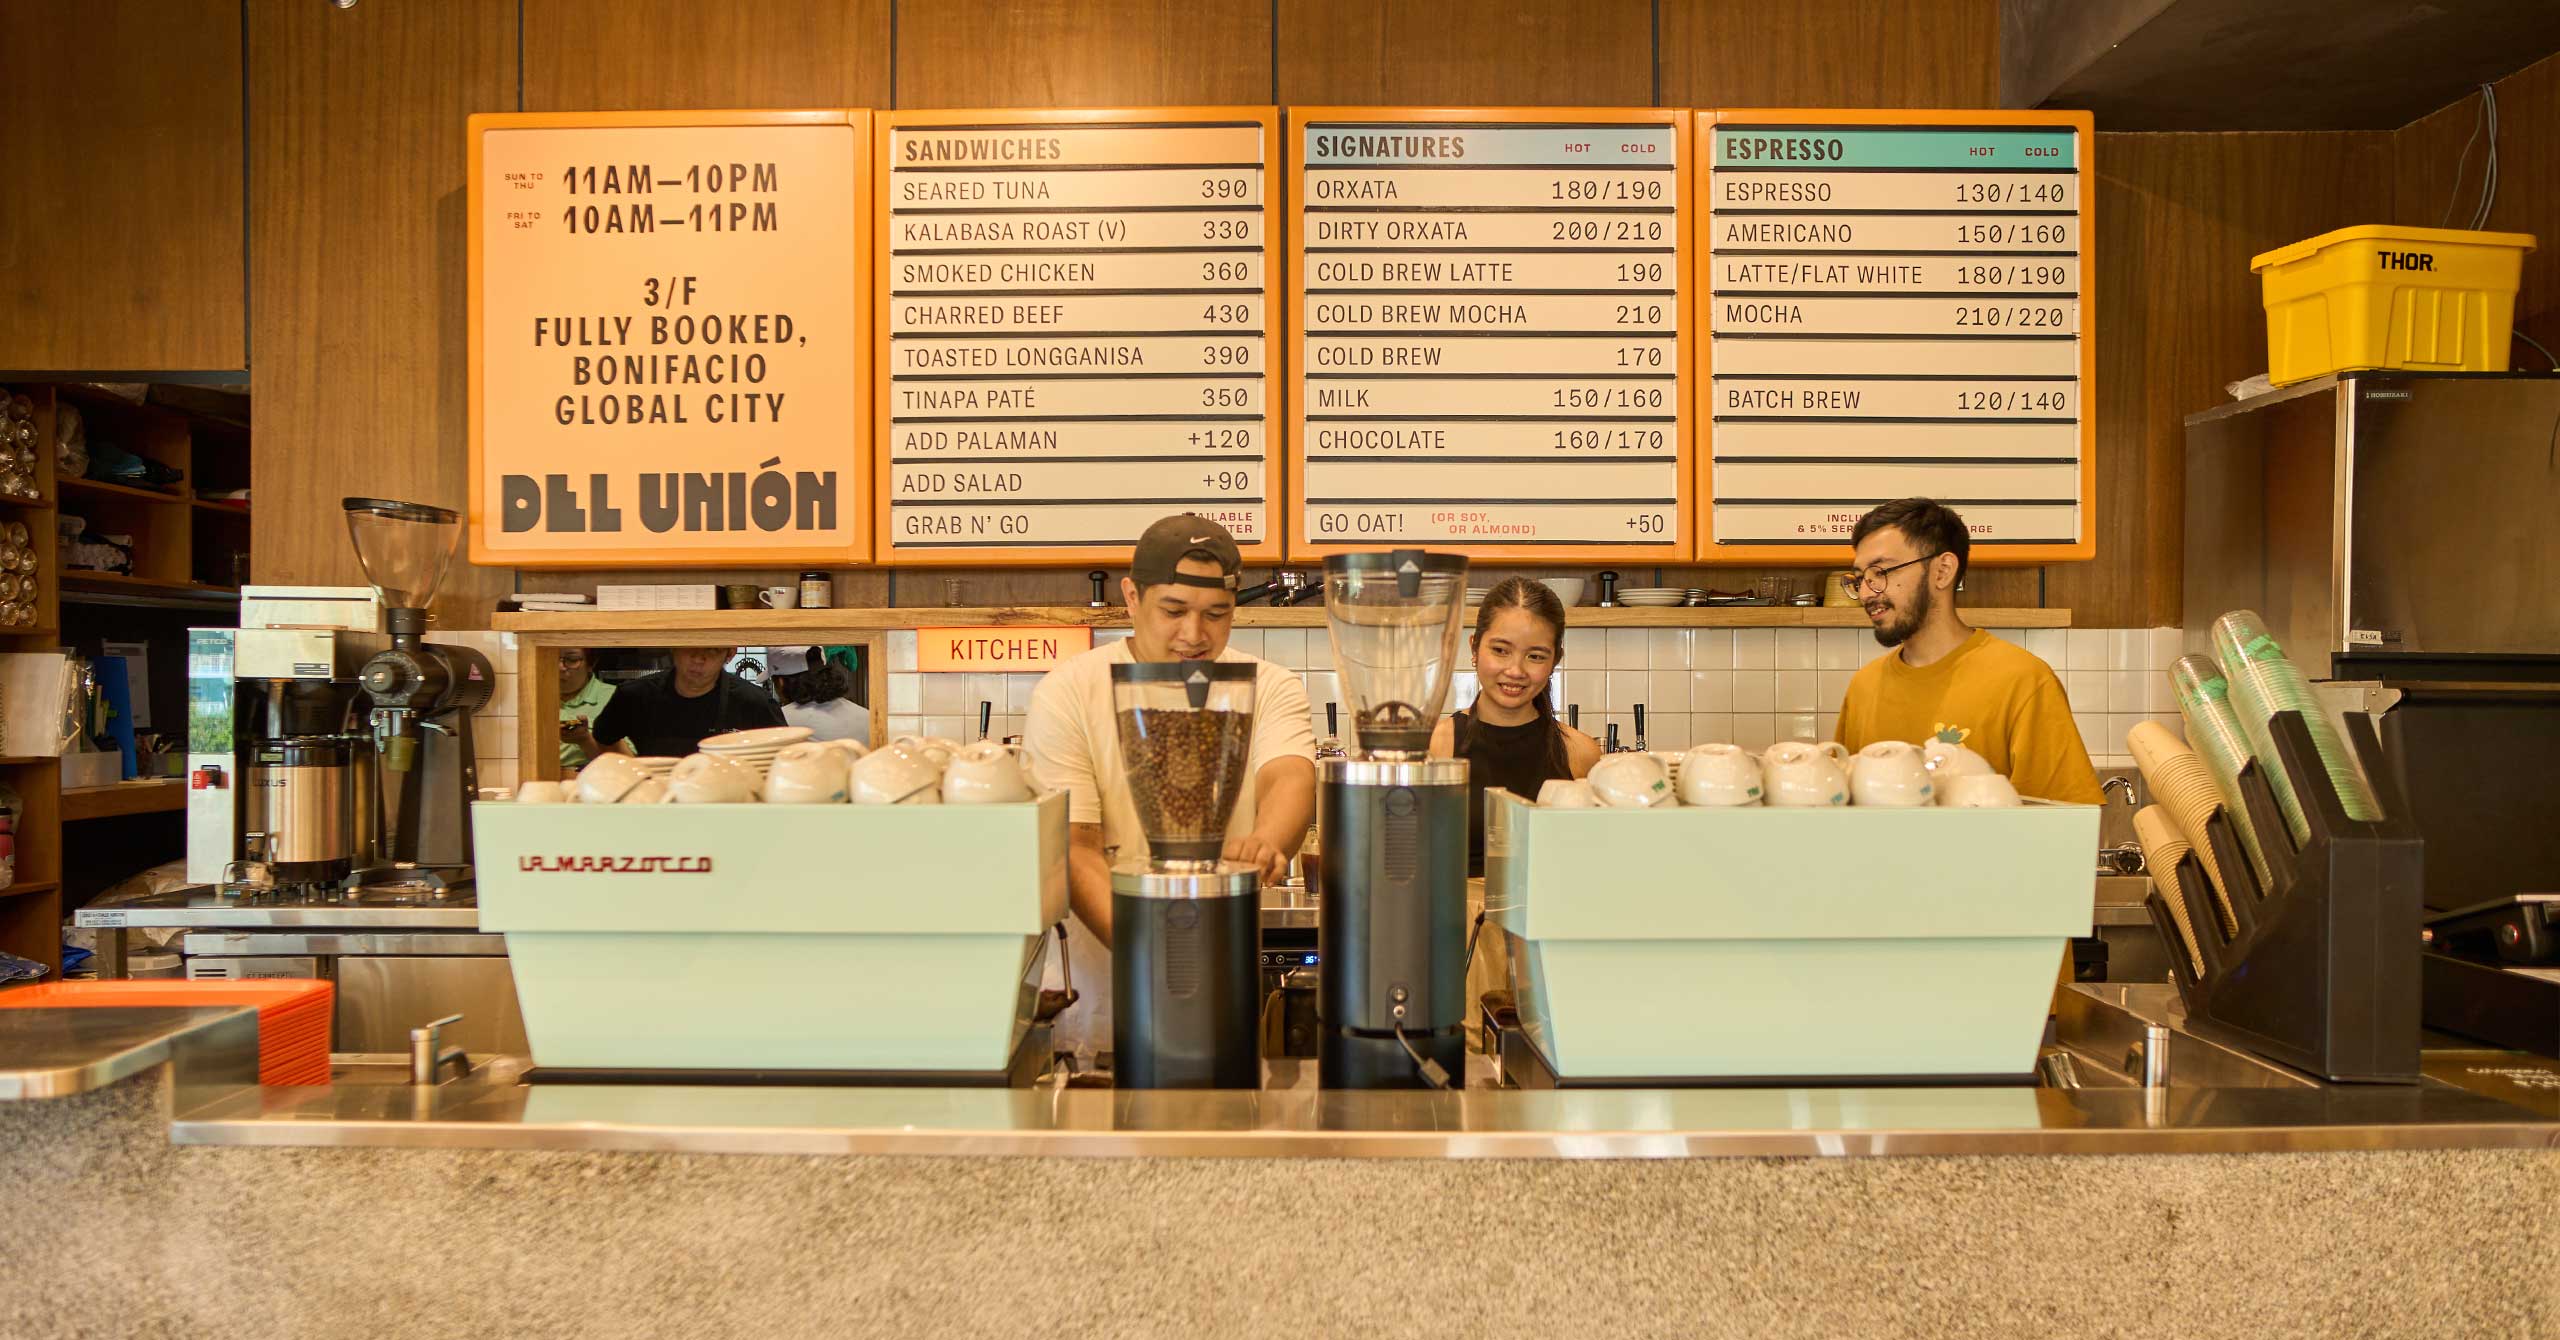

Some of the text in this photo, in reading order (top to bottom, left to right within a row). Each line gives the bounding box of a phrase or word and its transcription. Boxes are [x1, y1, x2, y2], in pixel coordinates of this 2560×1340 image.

[905, 138, 1061, 162] SANDWICHES
[1316, 135, 1656, 158] SIGNATURES HOT COLD
[1726, 137, 2059, 162] ESPRESSO HOT COLD
[505, 173, 544, 181] SUN TO
[903, 179, 1247, 201] SEARED TUNA 390
[1316, 179, 1662, 201] ORXATA 180/190
[1726, 182, 2064, 203] ESPRESSO 130/140
[514, 221, 534, 229] SAT
[905, 219, 1249, 243] KALABASA ROAST (V) 330
[1318, 221, 1662, 241] DIRTY ORXATA 200/210
[1726, 223, 2066, 244] AMERICANO 150/160
[1317, 262, 1662, 282] COLD BREW LATTE 190
[2377, 251, 2434, 272] THOR
[903, 261, 1248, 284] SMOKED CHICKEN 360
[1727, 262, 2066, 286] LATTE/FLAT WHITE 180/190
[643, 276, 697, 310] 3/F
[904, 304, 1249, 325] CHARRED BEEF 430
[1317, 304, 1662, 325] COLD BREW MOCHA 210
[1726, 304, 2063, 327] MOCHA 210/220
[534, 314, 807, 348] FULLY BOOKED,
[903, 345, 1249, 368] TOASTED LONGGANISA 390
[1317, 346, 1662, 367] COLD BREW 170
[573, 353, 767, 386] BONIFACIO
[902, 385, 1248, 410] TINAPA PATÉ 350
[1319, 388, 1663, 408] MILK 150/160
[1728, 389, 2066, 411] BATCH BREW 120/140
[554, 392, 785, 426] GLOBAL CITY
[904, 429, 1250, 451] ADD PALAMAN +120
[1319, 430, 1663, 450] CHOCOLATE 160/170
[902, 471, 1249, 493] ADD SALAD +90
[500, 455, 837, 534] DEL UNIÓN
[905, 515, 962, 535] GRAB
[999, 514, 1029, 535] GO
[1319, 513, 1403, 533] GO OAT!
[1431, 513, 1456, 524] (OR
[1625, 514, 1664, 534] +50
[1797, 525, 1805, 533] &
[1810, 525, 1827, 533] 5%
[1449, 524, 1537, 536] OR ALMOND)
[951, 639, 1058, 660] KITCHEN
